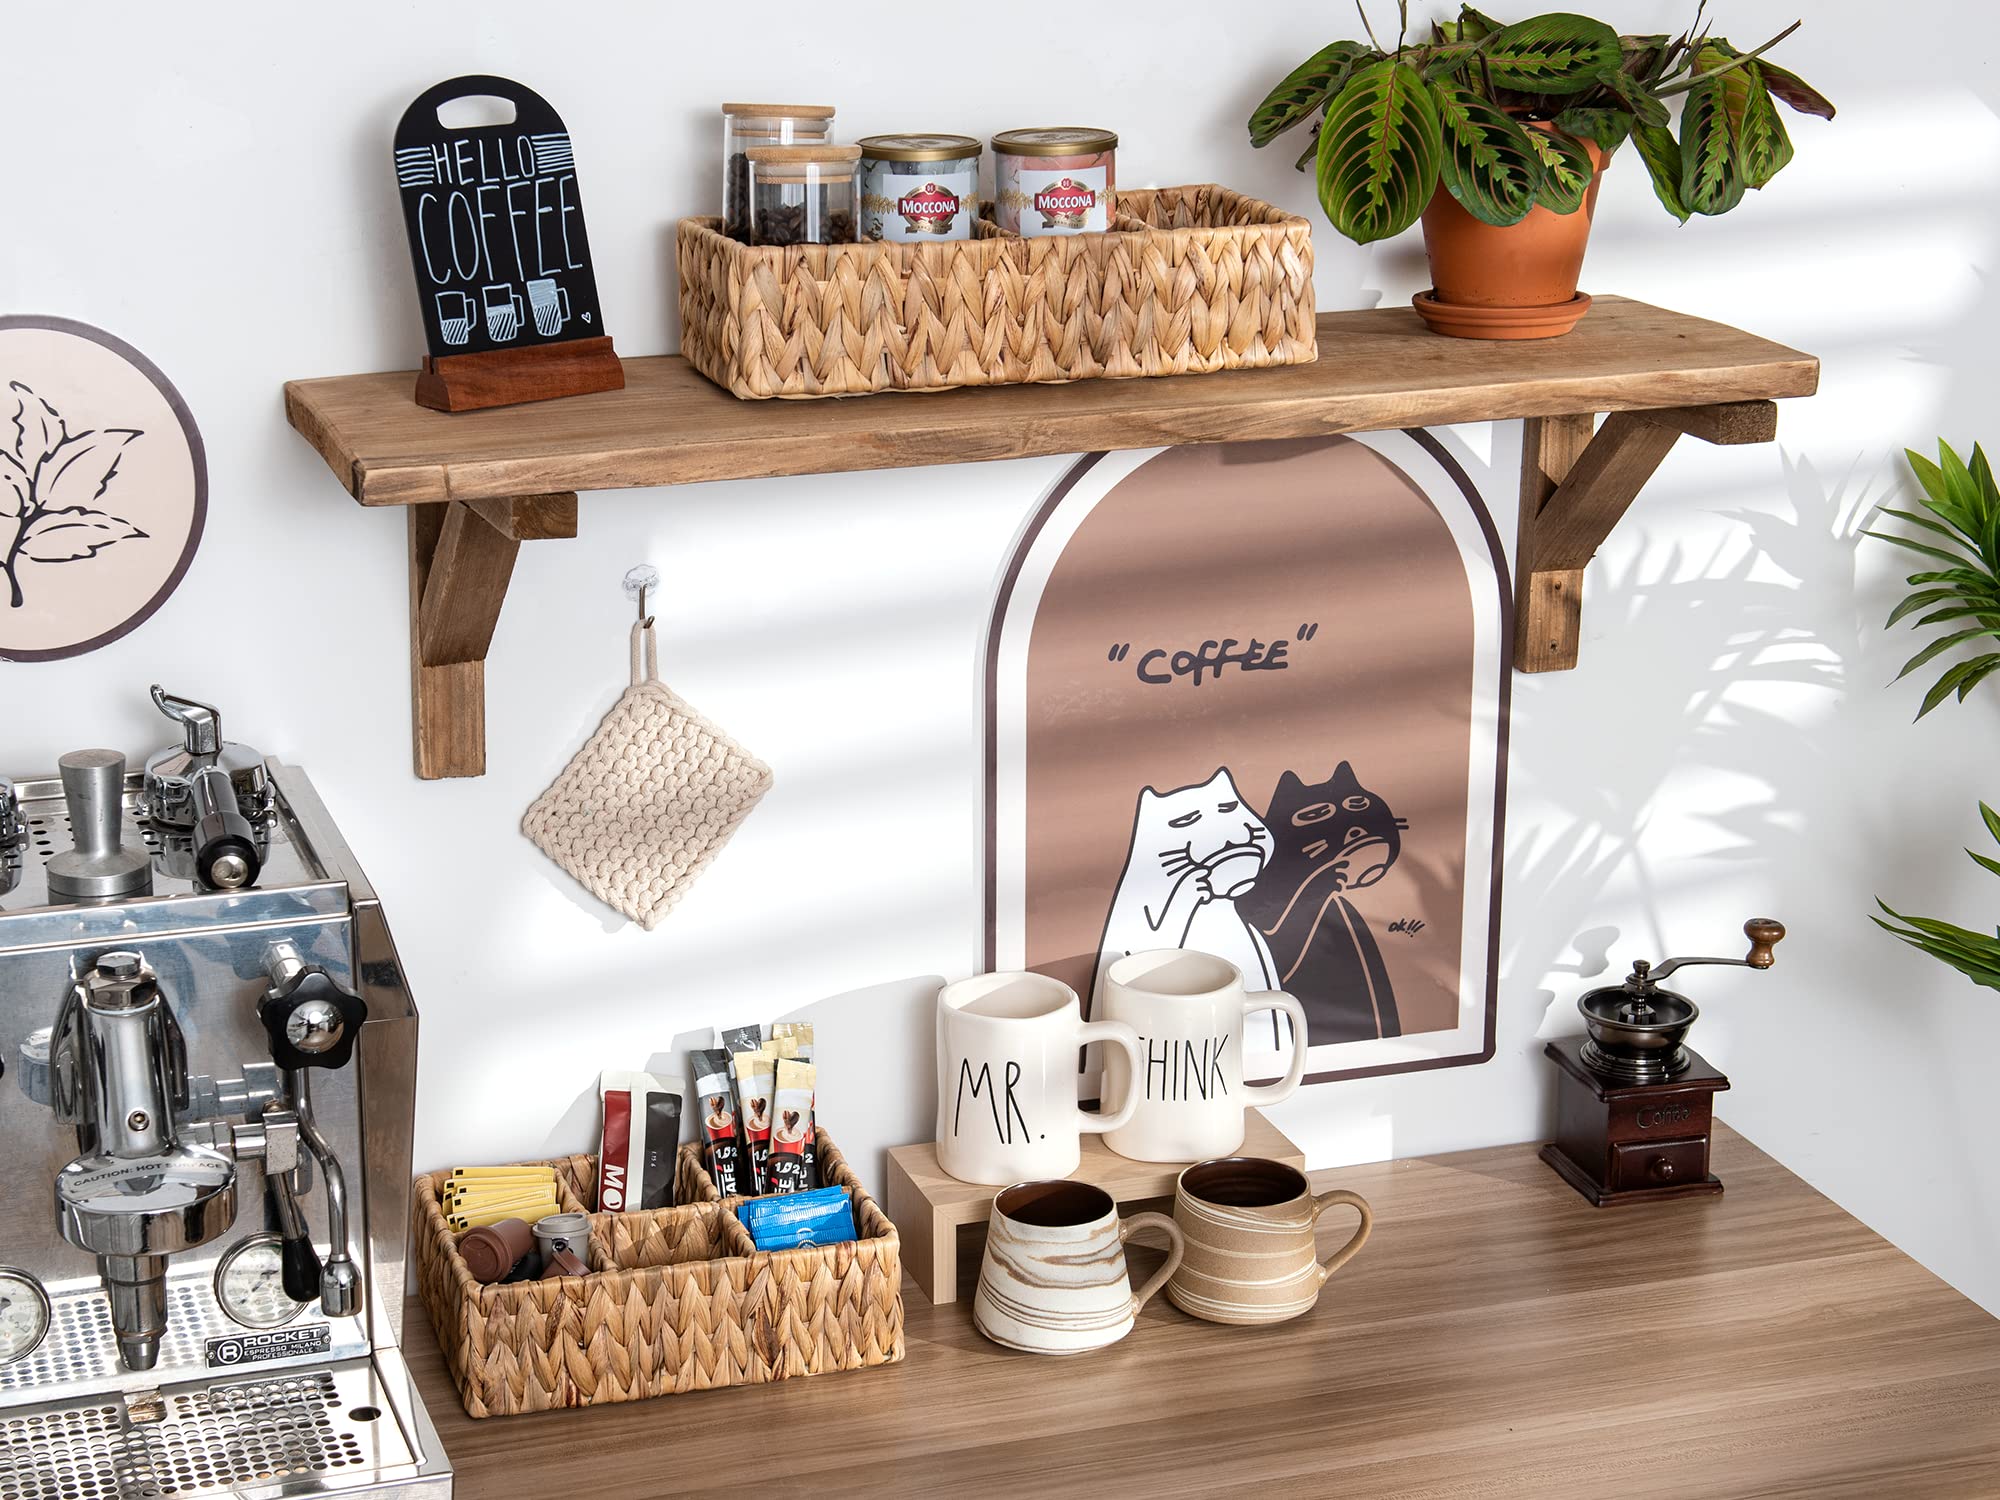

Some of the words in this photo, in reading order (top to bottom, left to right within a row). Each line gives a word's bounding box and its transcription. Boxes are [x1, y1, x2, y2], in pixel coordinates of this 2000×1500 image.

[431, 135, 536, 186] HELLO
[902, 199, 957, 214] MOCCONA
[1038, 194, 1093, 209] MOCCONA
[418, 174, 583, 285] COFFEE
[1138, 1033, 1229, 1101] HINK
[954, 1057, 1046, 1145] MR.
[74, 1167, 133, 1187] CAUTION:
[136, 1162, 163, 1173] HOT
[243, 1328, 320, 1348] ROCKET
[244, 1345, 288, 1357] ESPRESSO
[291, 1340, 322, 1350] MILANO
[252, 1347, 314, 1361] PROFESSIONALE
